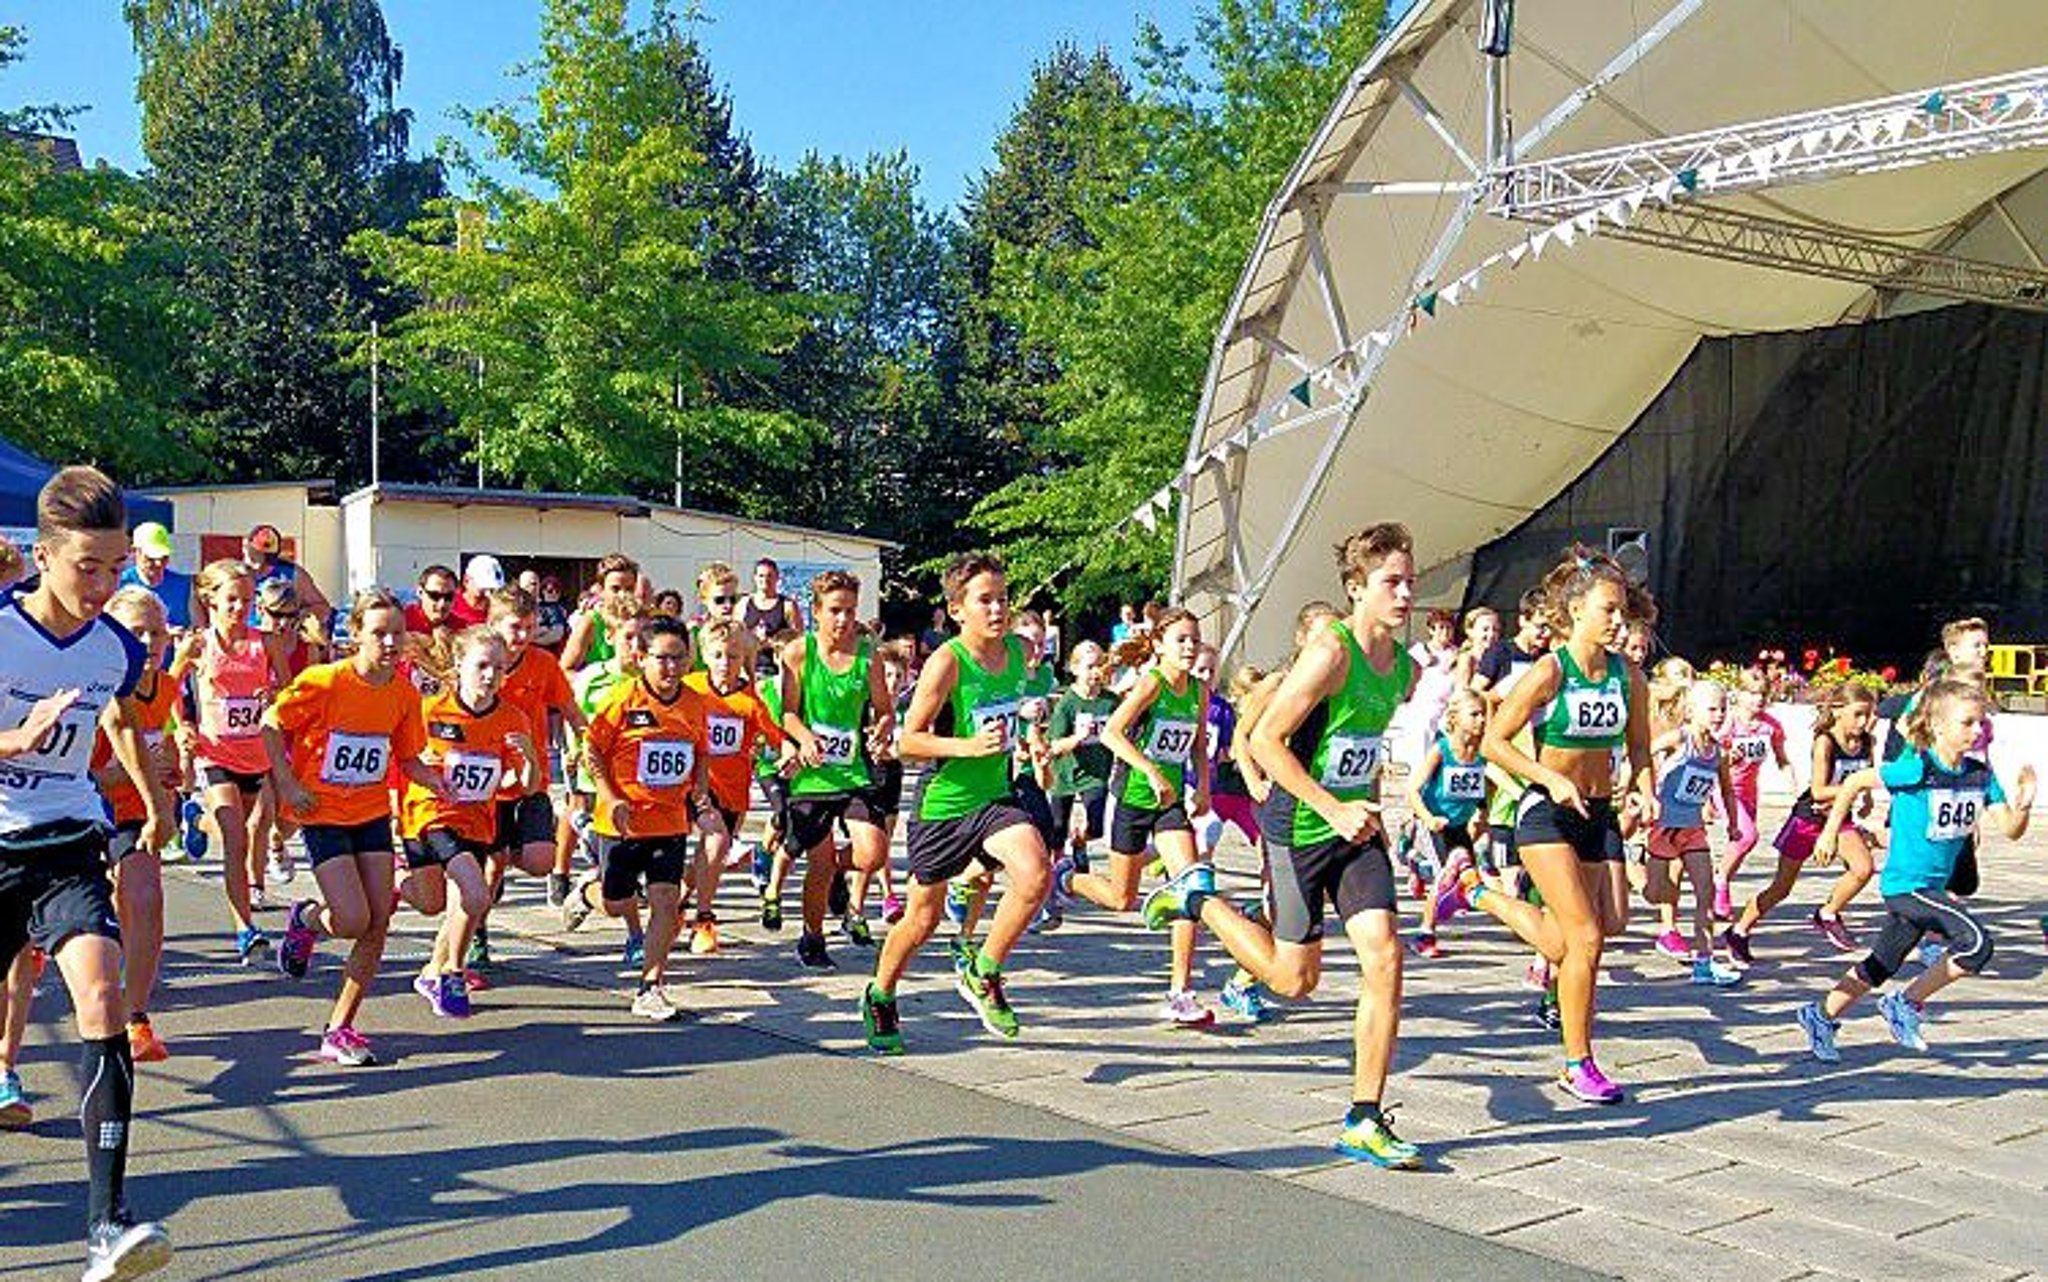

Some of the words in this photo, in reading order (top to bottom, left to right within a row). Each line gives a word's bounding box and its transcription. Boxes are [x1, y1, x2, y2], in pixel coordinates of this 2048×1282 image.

[1578, 701, 1619, 728] 623
[708, 724, 736, 746] 60
[334, 745, 381, 773] 646
[647, 750, 687, 776] 666
[1338, 748, 1376, 777] 621
[451, 763, 494, 792] 657
[1938, 801, 1976, 828] 648
